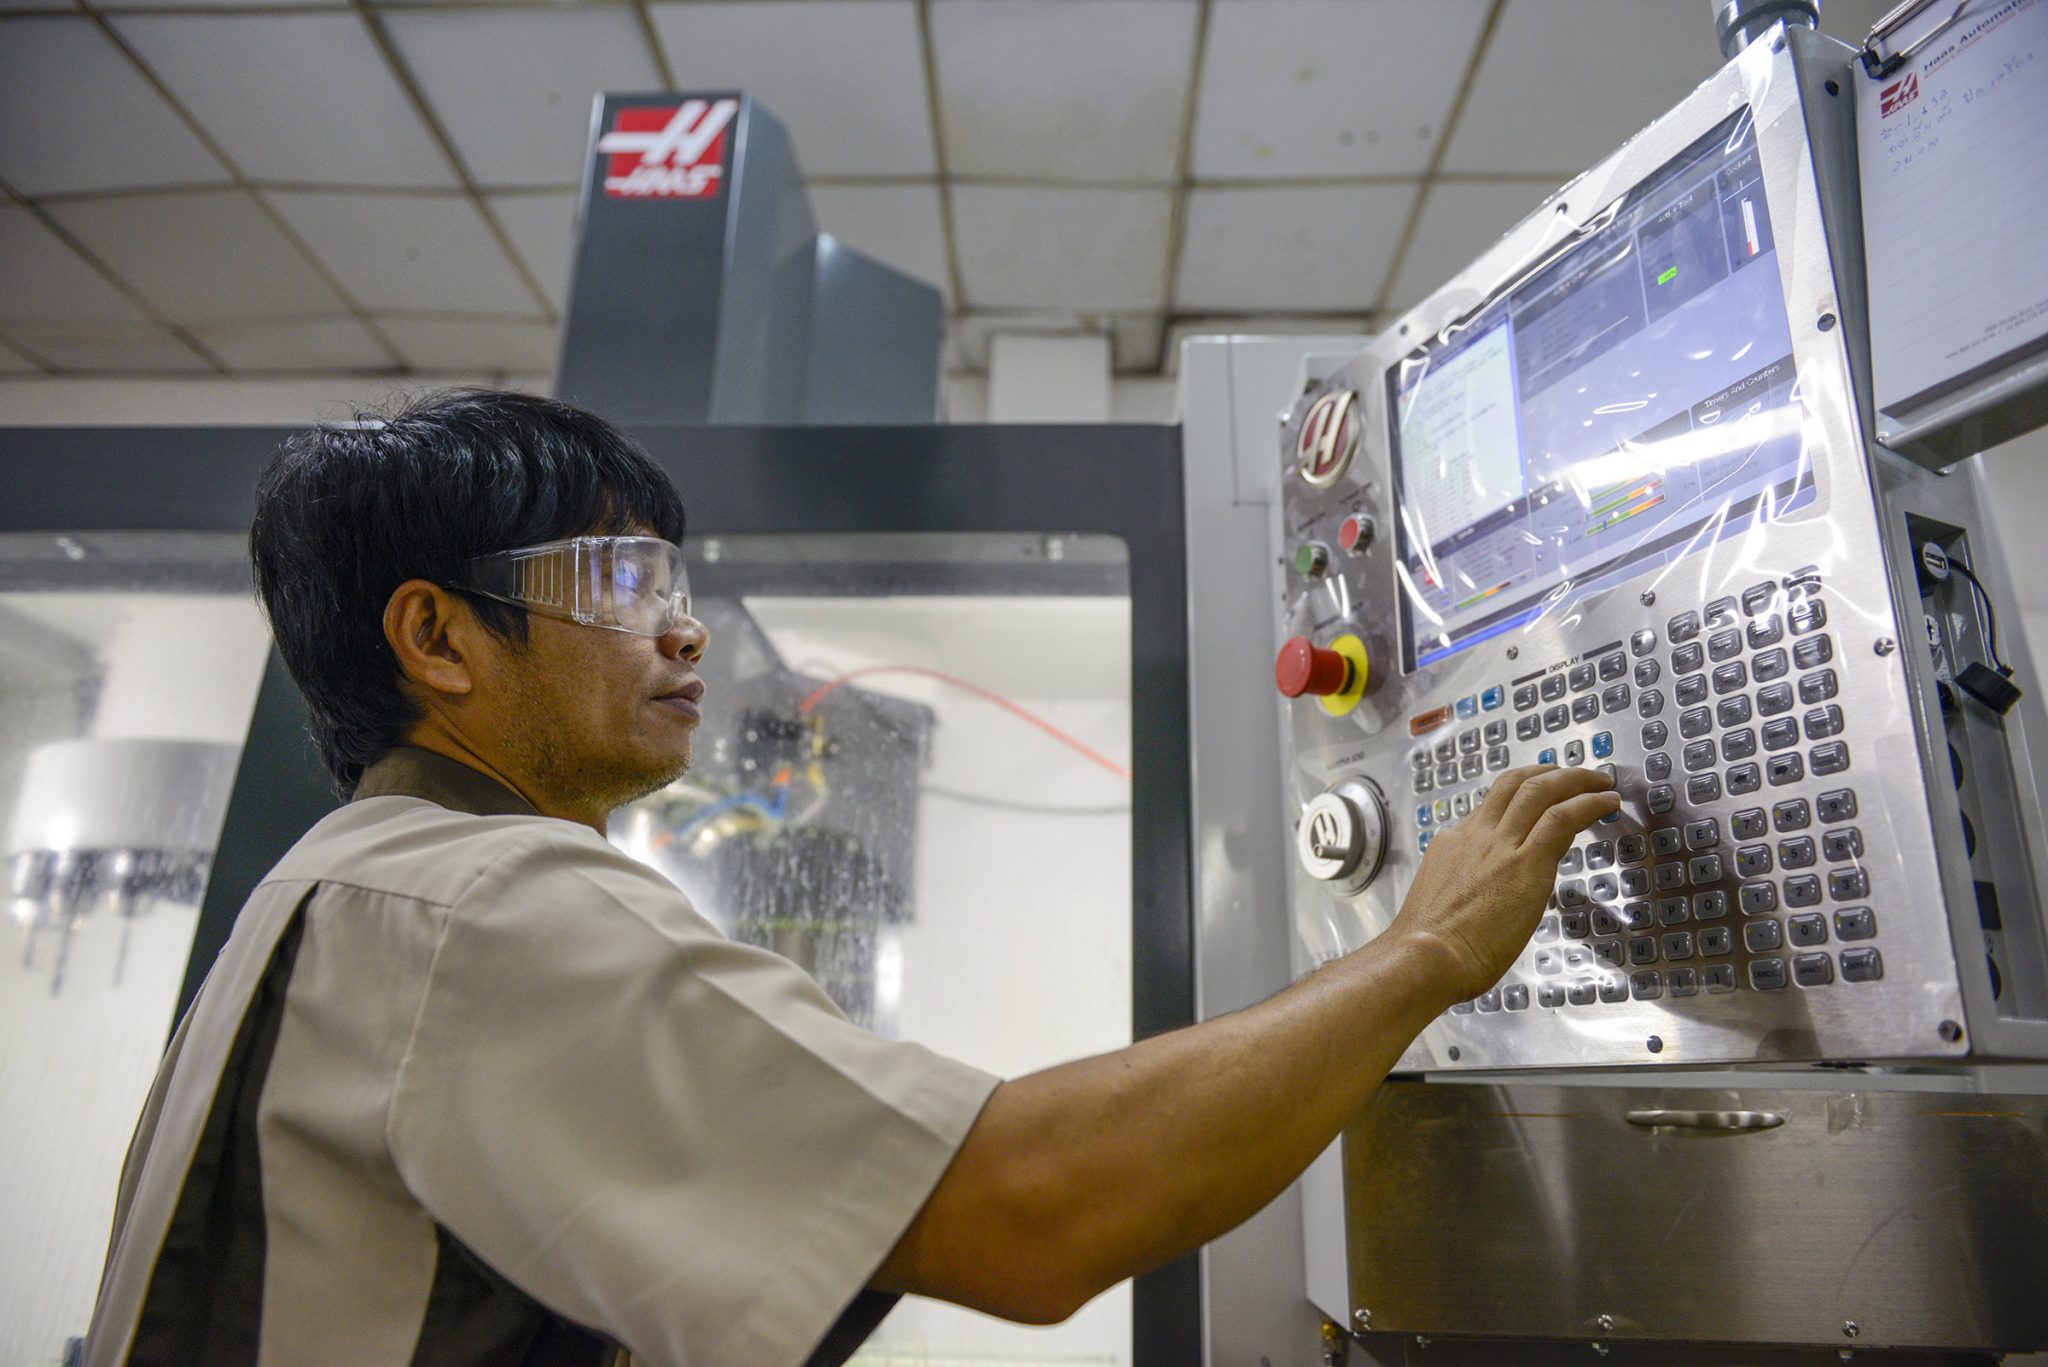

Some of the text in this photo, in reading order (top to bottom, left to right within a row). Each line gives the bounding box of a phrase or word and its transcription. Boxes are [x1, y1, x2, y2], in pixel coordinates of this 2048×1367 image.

[1924, 46, 1955, 71] Haas
[1704, 390, 1730, 409] Timers
[1746, 363, 1781, 387] Counters
[1549, 656, 1579, 673] DISPLAY
[1830, 802, 1838, 812] 9
[1785, 811, 1793, 822] 8
[1743, 819, 1750, 830] 7
[1696, 829, 1704, 840] E
[1660, 837, 1668, 847] D
[1836, 840, 1844, 850] 6
[1627, 844, 1634, 854] C
[1791, 849, 1798, 859] 5
[1748, 856, 1755, 866] 4
[1701, 864, 1708, 875] K
[1665, 871, 1671, 881] J
[1842, 878, 1850, 889] 3
[1566, 889, 1574, 898] G
[1796, 886, 1803, 897] 2
[1754, 892, 1760, 903] 1
[1704, 899, 1713, 911] Q
[1668, 906, 1676, 916] P
[1601, 916, 1608, 927] N
[1801, 925, 1809, 936] 0
[1672, 940, 1680, 950] V
[1707, 936, 1718, 947] W
[1604, 949, 1611, 958] T
[1637, 944, 1645, 954] U
